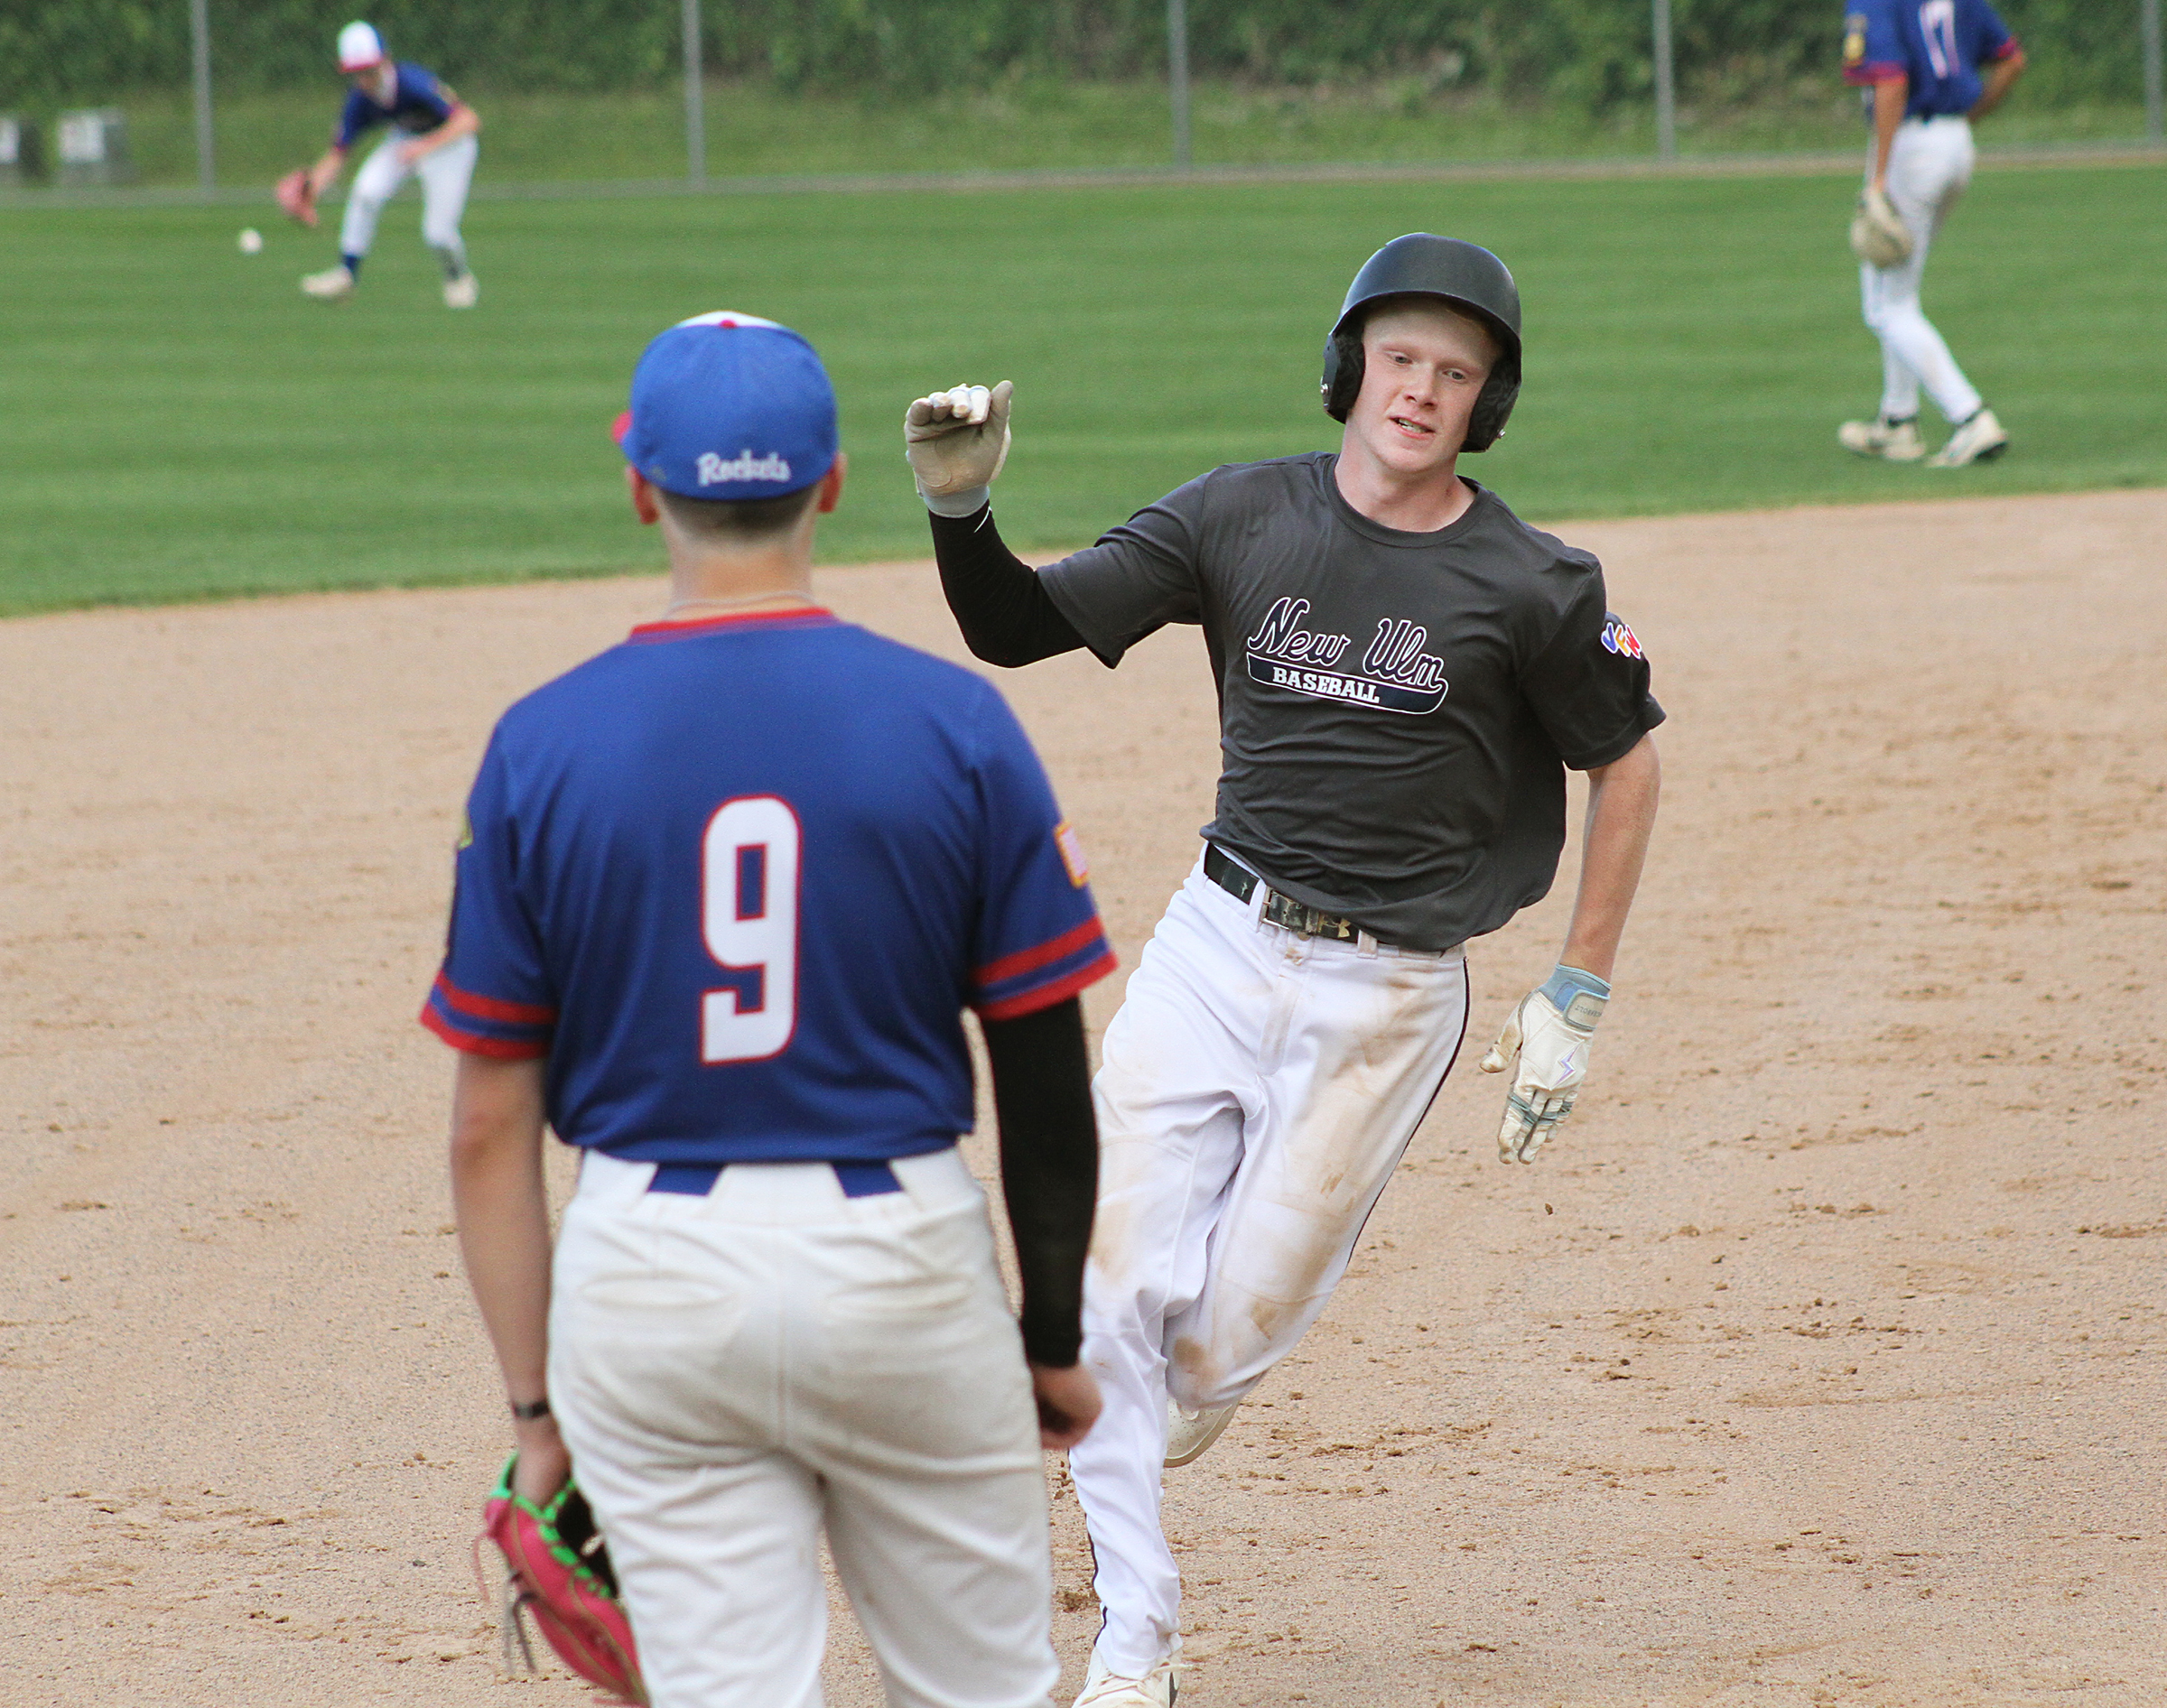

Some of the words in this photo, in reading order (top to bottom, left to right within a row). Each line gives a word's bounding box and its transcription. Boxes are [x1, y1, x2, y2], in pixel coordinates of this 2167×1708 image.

[1247, 597, 1352, 667] New
[1363, 617, 1446, 691] Ulm
[1272, 666, 1381, 704] BASEBALL
[699, 793, 804, 1066] 9
